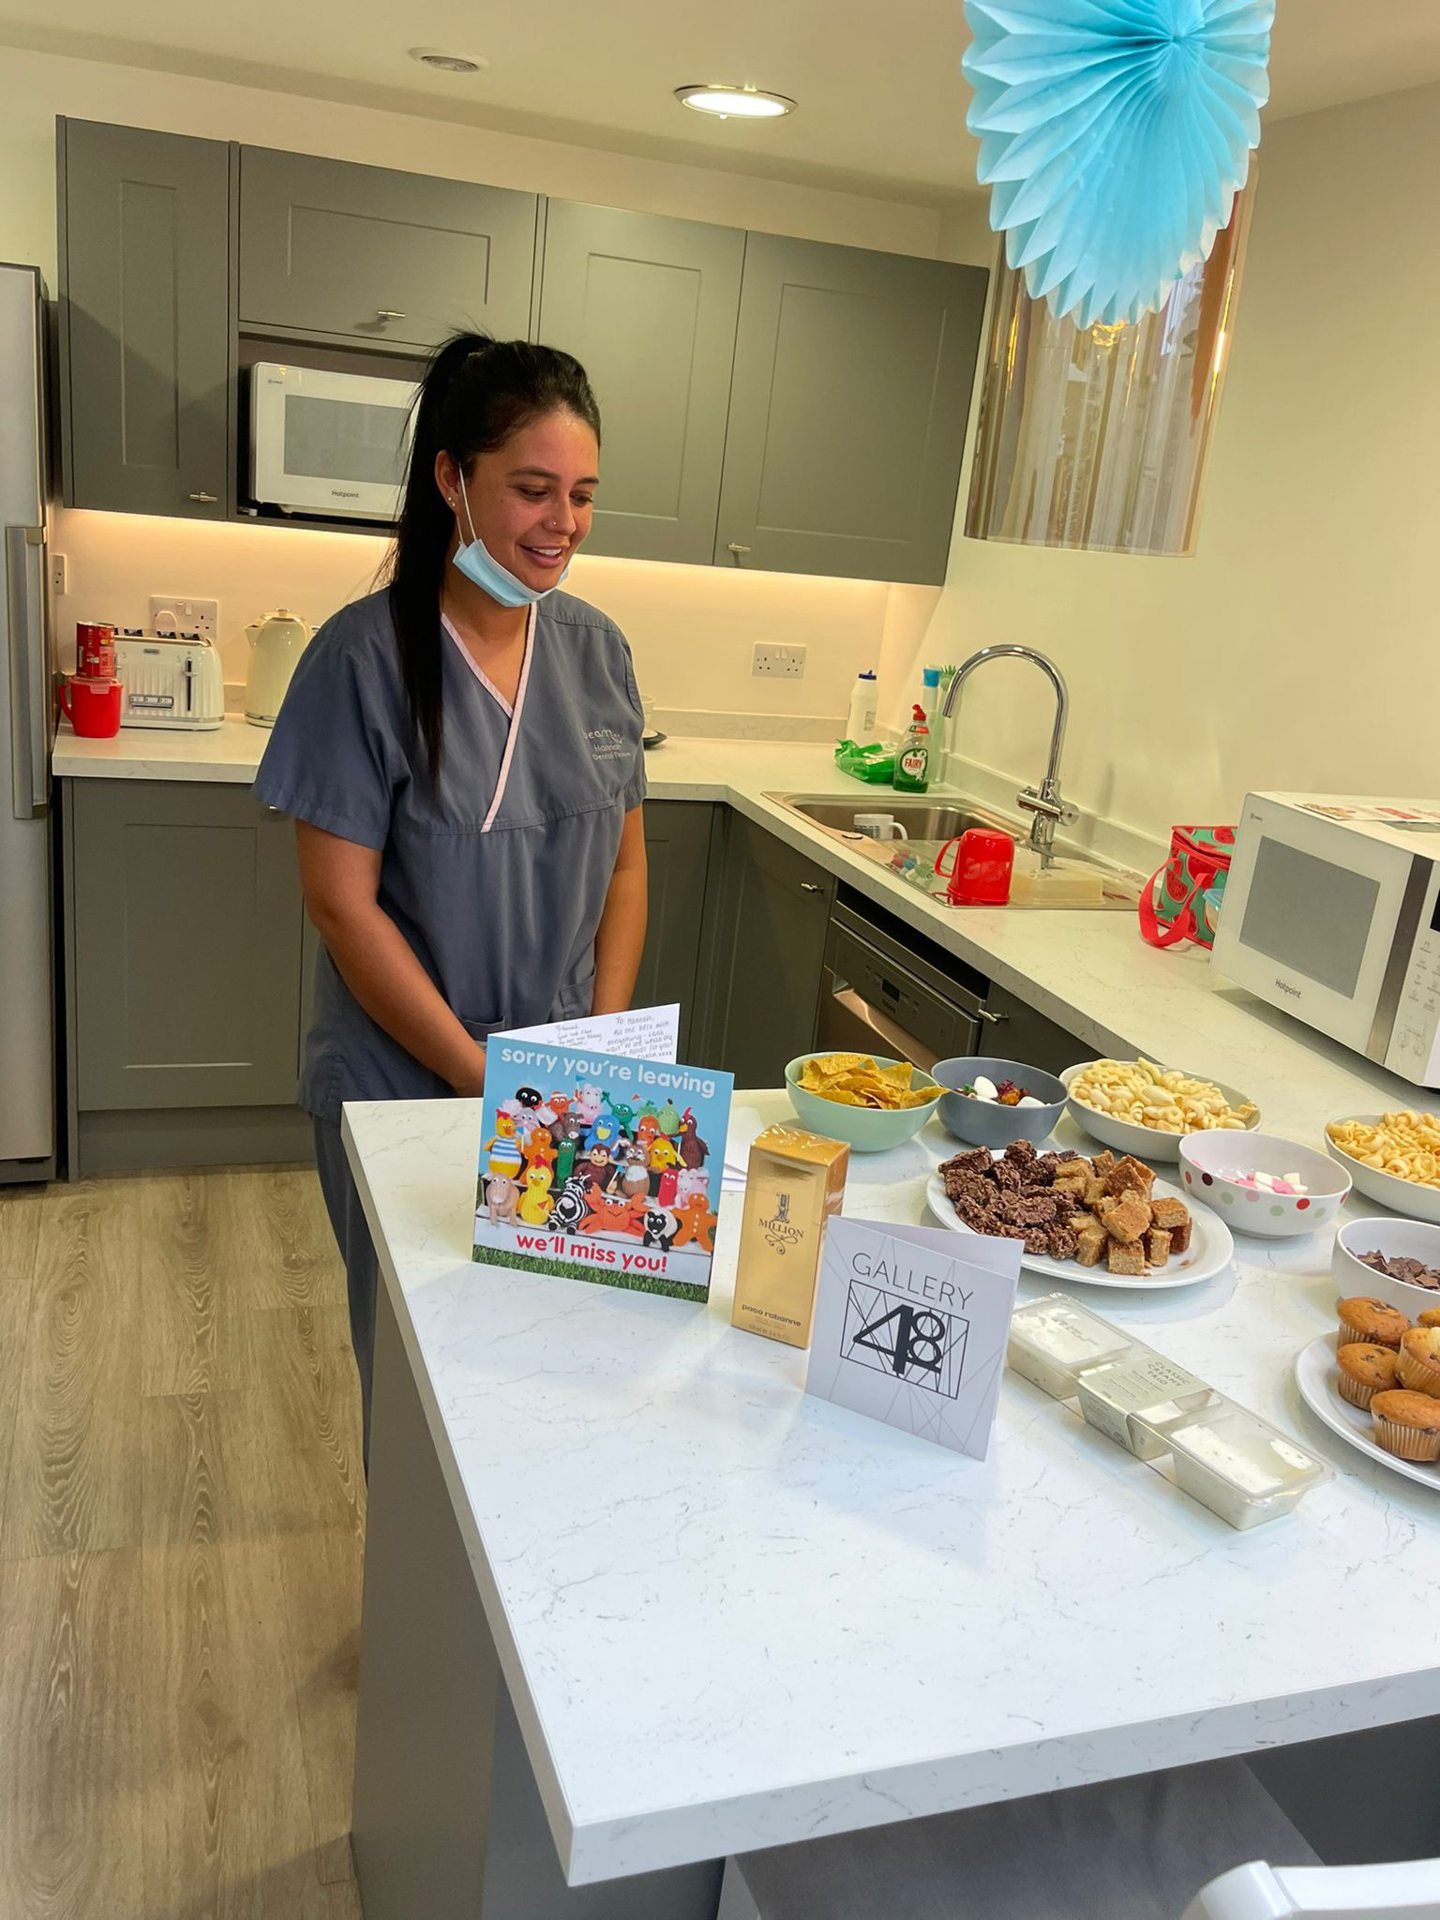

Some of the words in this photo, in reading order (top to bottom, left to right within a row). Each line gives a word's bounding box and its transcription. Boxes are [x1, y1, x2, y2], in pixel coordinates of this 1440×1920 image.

[331, 489, 360, 499] Hotpoint
[904, 757, 923, 769] FAIRY
[1275, 978, 1302, 999] Hotpoint
[501, 1047, 557, 1074] sorry
[563, 1057, 633, 1082] you're
[637, 1064, 716, 1099] leaving
[758, 1218, 804, 1238] MILLION
[516, 1233, 565, 1255] we'll
[570, 1242, 616, 1264] miss
[622, 1253, 668, 1273] you!
[852, 1252, 975, 1311] GALLERY
[852, 1303, 947, 1375] 48
